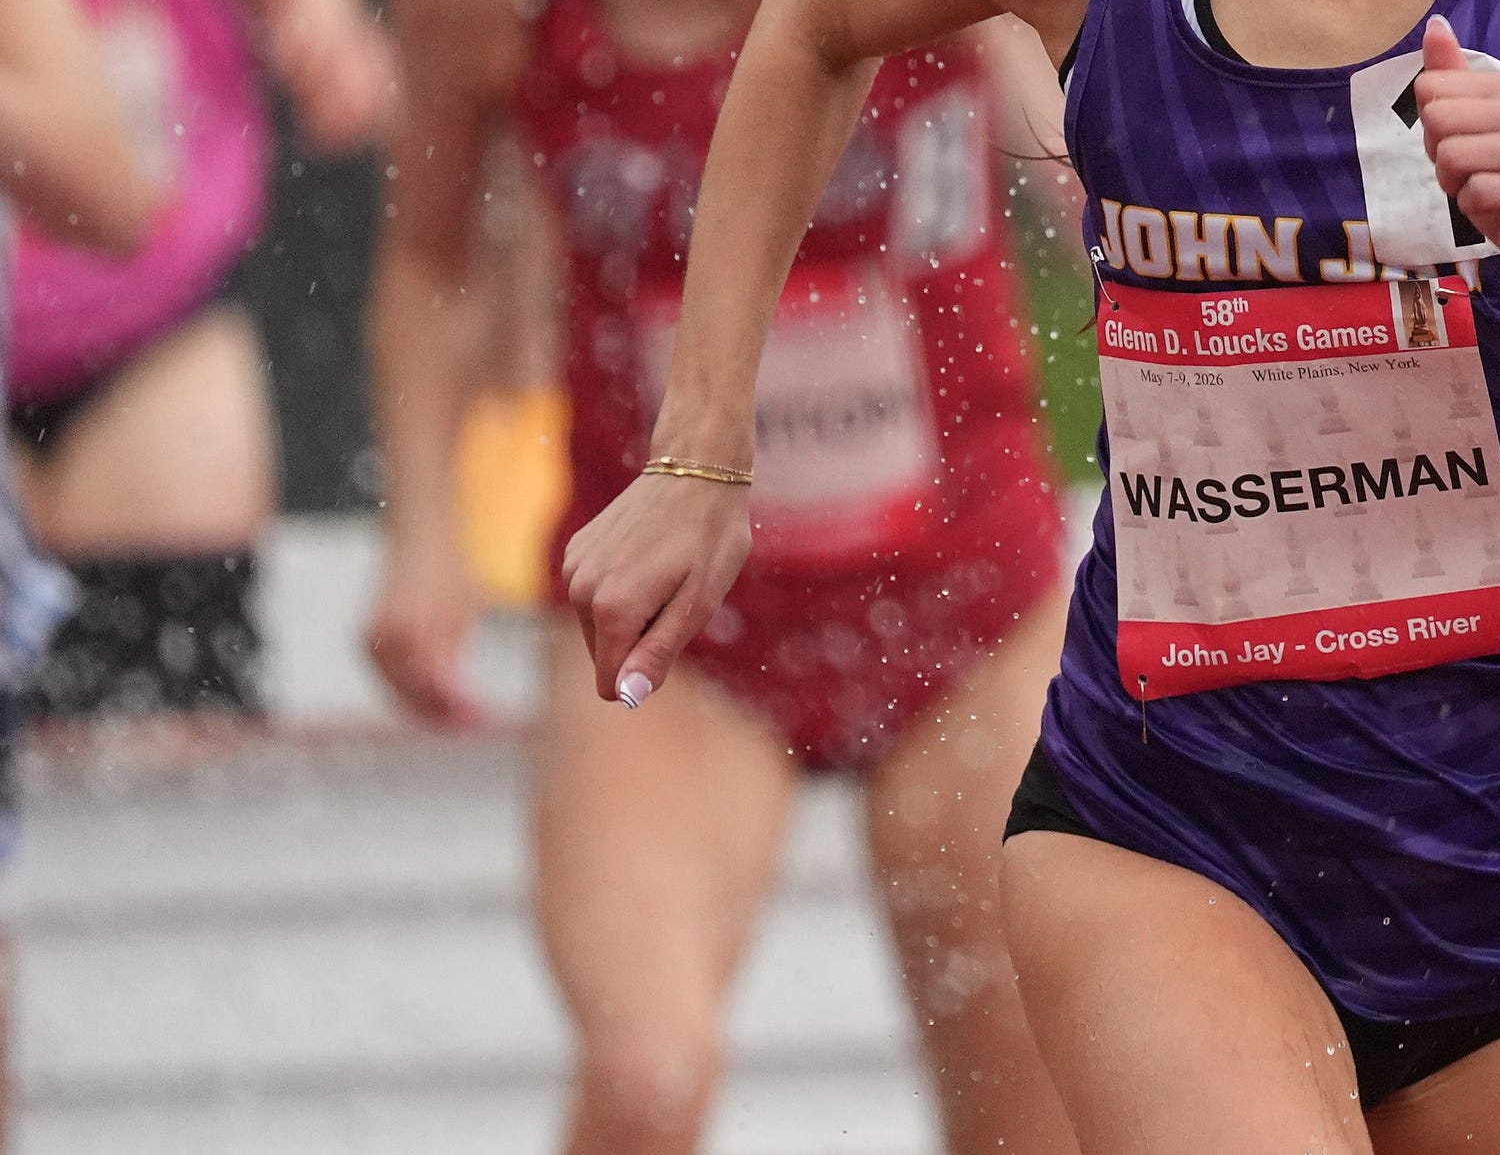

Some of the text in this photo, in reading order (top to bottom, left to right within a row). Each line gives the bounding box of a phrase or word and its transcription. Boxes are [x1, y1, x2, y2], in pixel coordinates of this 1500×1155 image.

[1100, 198, 1306, 283] JOHN
[1200, 296, 1249, 327] 58th
[1104, 319, 1389, 356] Glenn D. Loucks Games
[1140, 368, 1224, 387] May 7-9, 2026
[1252, 356, 1421, 383] White Plains, New York
[1119, 447, 1489, 524] WASSERMAN
[1161, 643, 1229, 668] John
[1236, 640, 1286, 665] Jay
[1315, 625, 1399, 655] Cross
[1407, 612, 1482, 642] River
